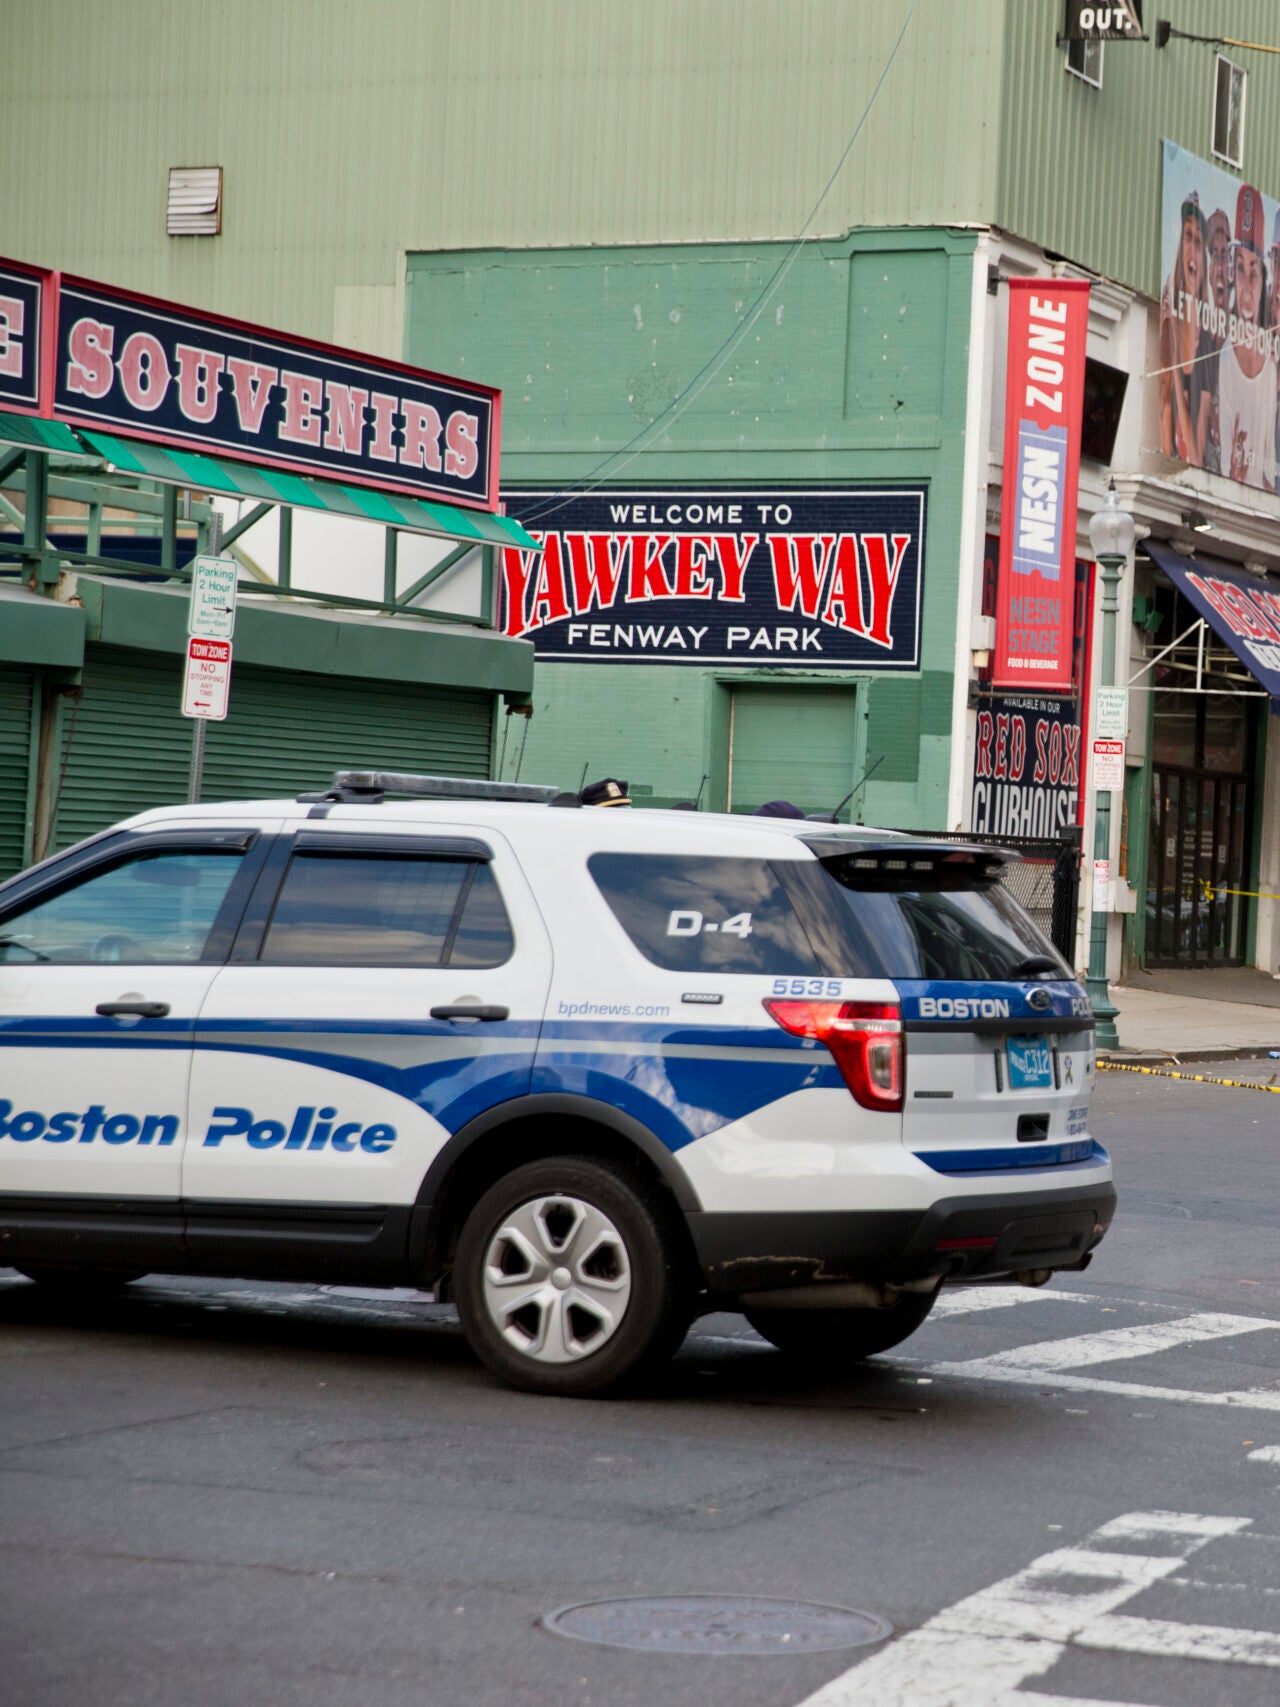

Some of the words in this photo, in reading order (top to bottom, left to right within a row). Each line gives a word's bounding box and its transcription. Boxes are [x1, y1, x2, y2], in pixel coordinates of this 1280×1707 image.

[1079, 8, 1132, 30] OUT.
[1170, 286, 1194, 323] LET
[1195, 298, 1227, 340] YOUR
[1229, 313, 1273, 360] BOSTON
[1026, 295, 1068, 413] ZONE
[66, 316, 480, 480] SOUVENIRS
[1018, 445, 1060, 555] NESN
[610, 504, 743, 525] WELCOME
[757, 504, 793, 526] TO
[198, 566, 235, 582] Parking
[199, 578, 206, 589] 2
[208, 581, 231, 593] Hour
[502, 530, 760, 639] YAWKEY
[766, 533, 912, 651] WAY
[202, 593, 226, 606] Limit
[1009, 596, 1060, 626] NESN
[568, 624, 709, 649] FENWAY
[727, 627, 823, 651] PARK
[1008, 628, 1060, 655] STAGE
[191, 642, 208, 656] TOW
[208, 645, 229, 660] ZONE
[200, 662, 217, 674] NO
[1007, 657, 1023, 669] FOOD
[1029, 658, 1059, 670] BEVERAGE
[190, 673, 225, 684] STOPPING
[200, 682, 213, 690] ANY
[199, 689, 214, 698] TIME
[1098, 692, 1125, 702] Parking
[1003, 698, 1039, 711] AVAILABLE
[1039, 701, 1045, 711] IN
[1045, 702, 1061, 714] OUR
[1102, 709, 1121, 717] Limit
[976, 711, 1026, 782] RED
[1033, 717, 1081, 787] SOX
[971, 781, 1079, 839] CLUBHOUSE
[666, 910, 754, 939] D-4
[772, 978, 843, 998] 5535
[557, 1001, 671, 1019] bpdnews.com
[918, 997, 1010, 1019] BOSTON
[1024, 1049, 1051, 1075] C312
[0, 1097, 180, 1147] Boston
[202, 1105, 399, 1155] Police
